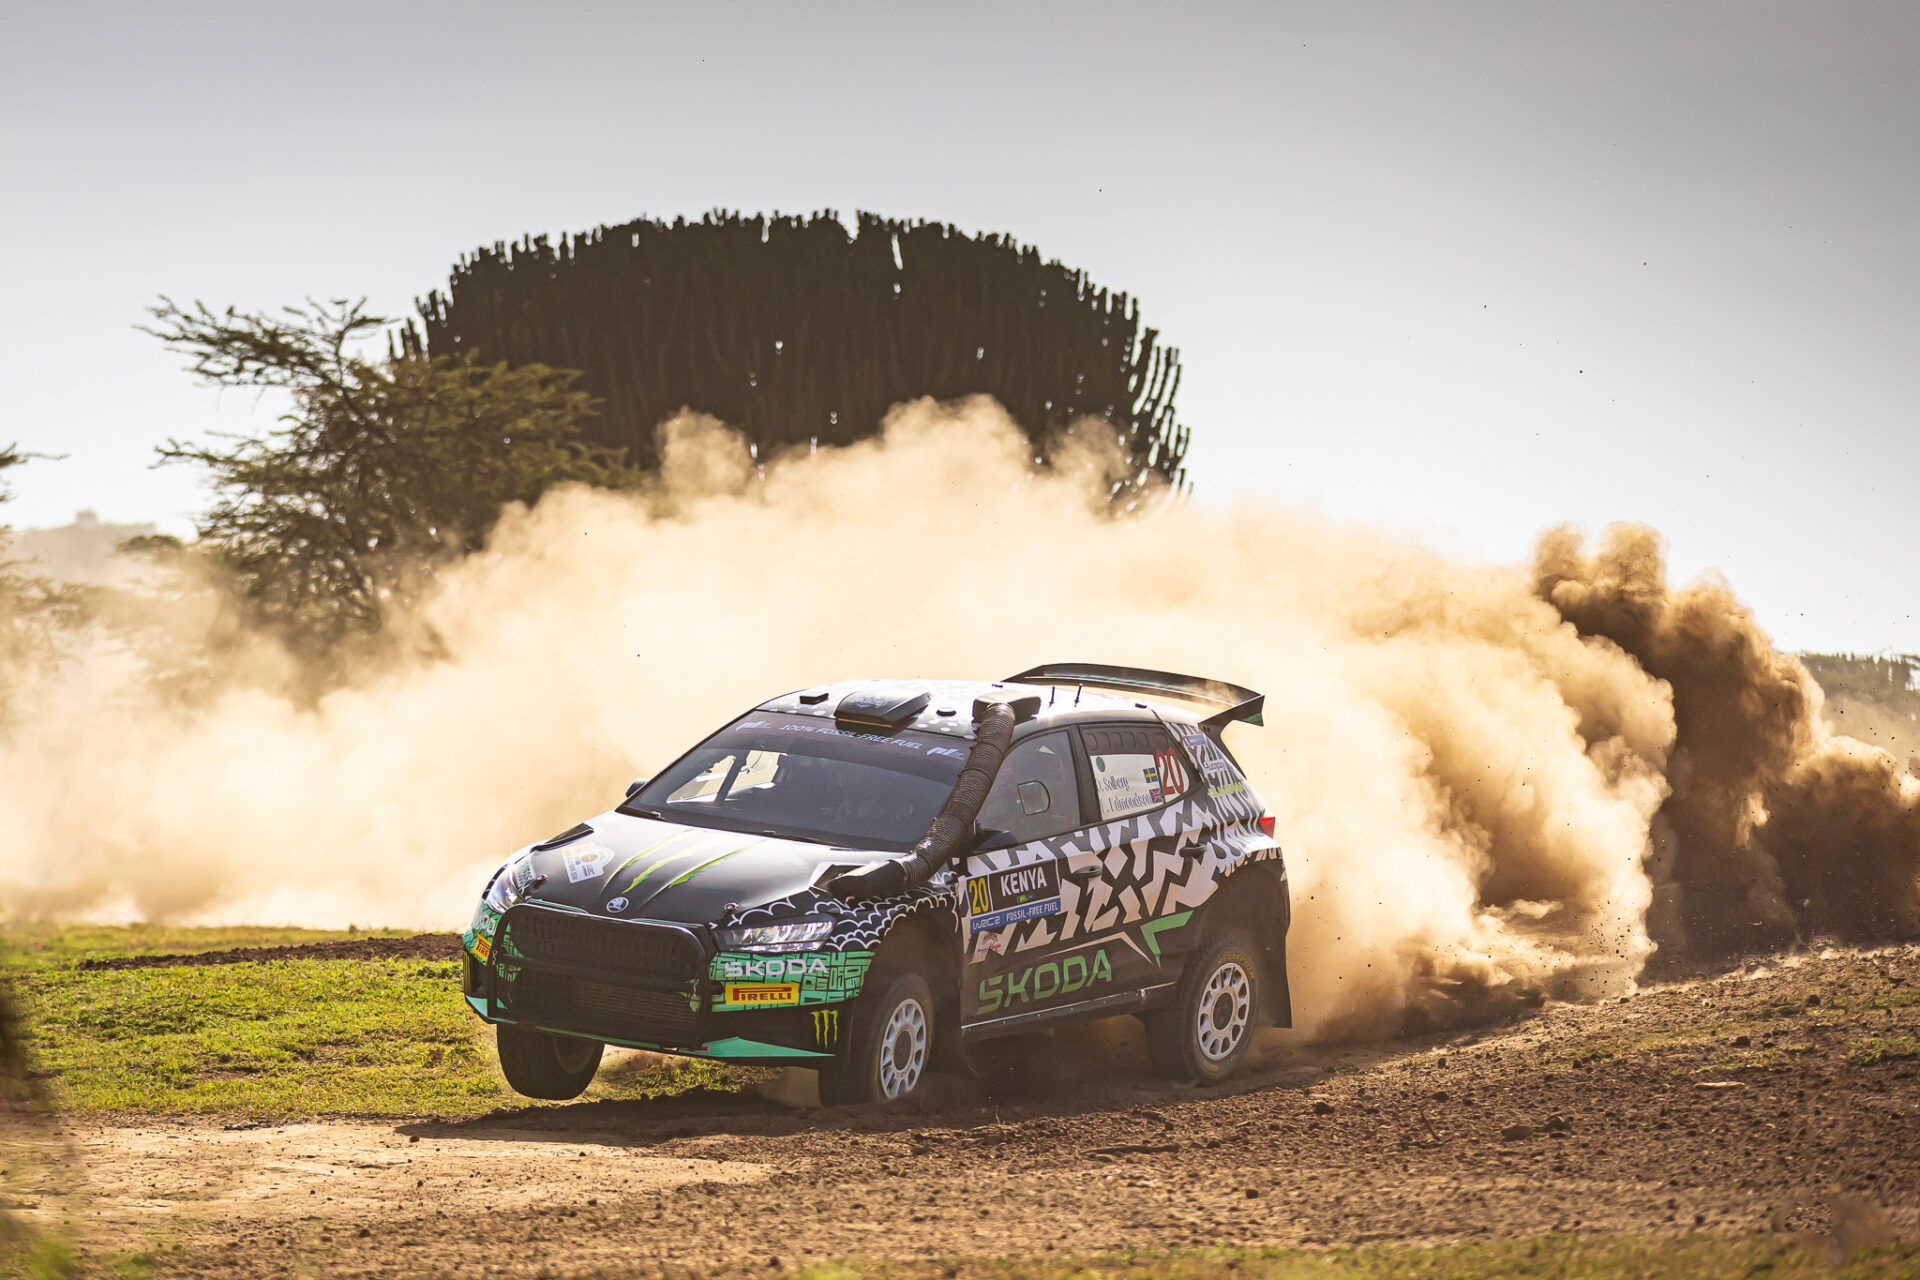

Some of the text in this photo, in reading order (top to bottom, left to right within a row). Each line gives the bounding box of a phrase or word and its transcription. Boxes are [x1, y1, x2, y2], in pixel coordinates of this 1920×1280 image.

[780, 723, 923, 750] 100% FOSSIL-FREE FUEL
[1102, 775, 1130, 791] Solberg
[1155, 747, 1184, 795] 20
[1000, 866, 1047, 897] KENYA
[968, 877, 989, 915] 20
[972, 902, 1059, 930] WRC2 FOSSIL-FREE FUEL
[733, 986, 793, 1001] PIRELLI
